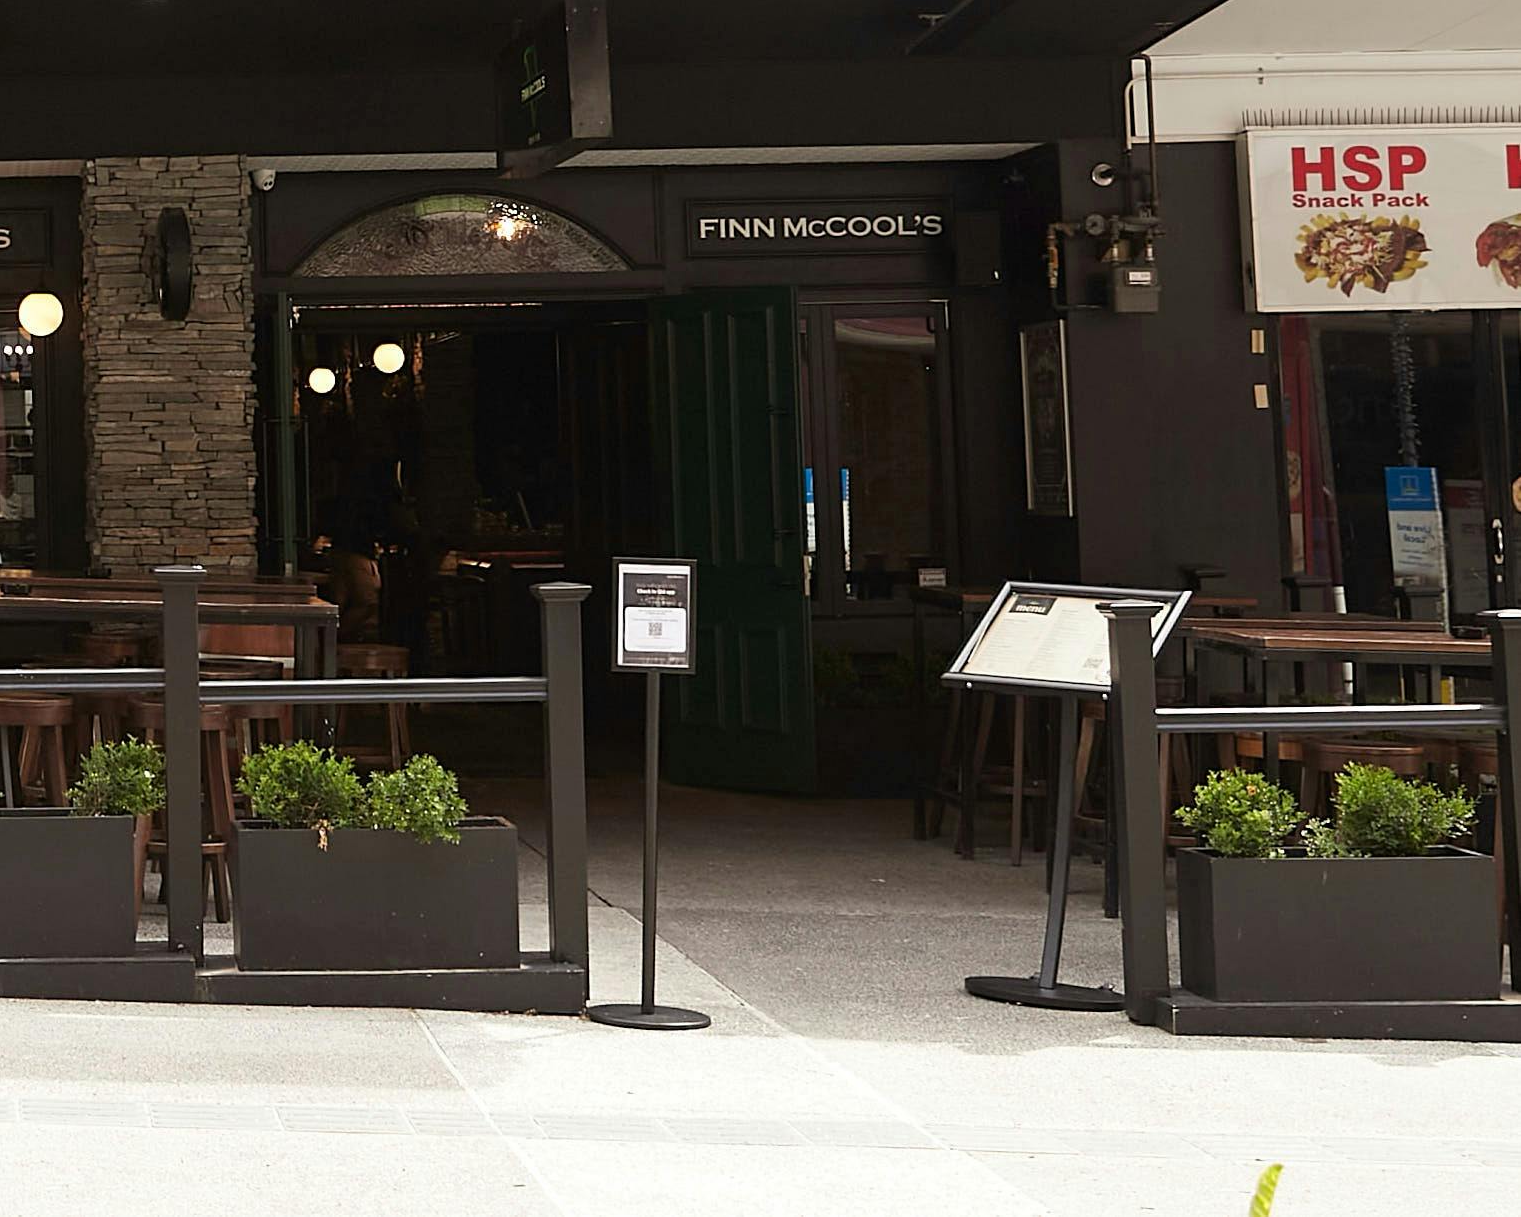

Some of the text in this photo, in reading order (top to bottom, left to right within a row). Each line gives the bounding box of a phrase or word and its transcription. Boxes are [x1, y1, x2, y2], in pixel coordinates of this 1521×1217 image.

[1291, 145, 1427, 192] HSP
[1291, 192, 1430, 208] Snack Pack
[699, 215, 943, 239] FINN McCOOL'S
[1015, 604, 1047, 613] menu
